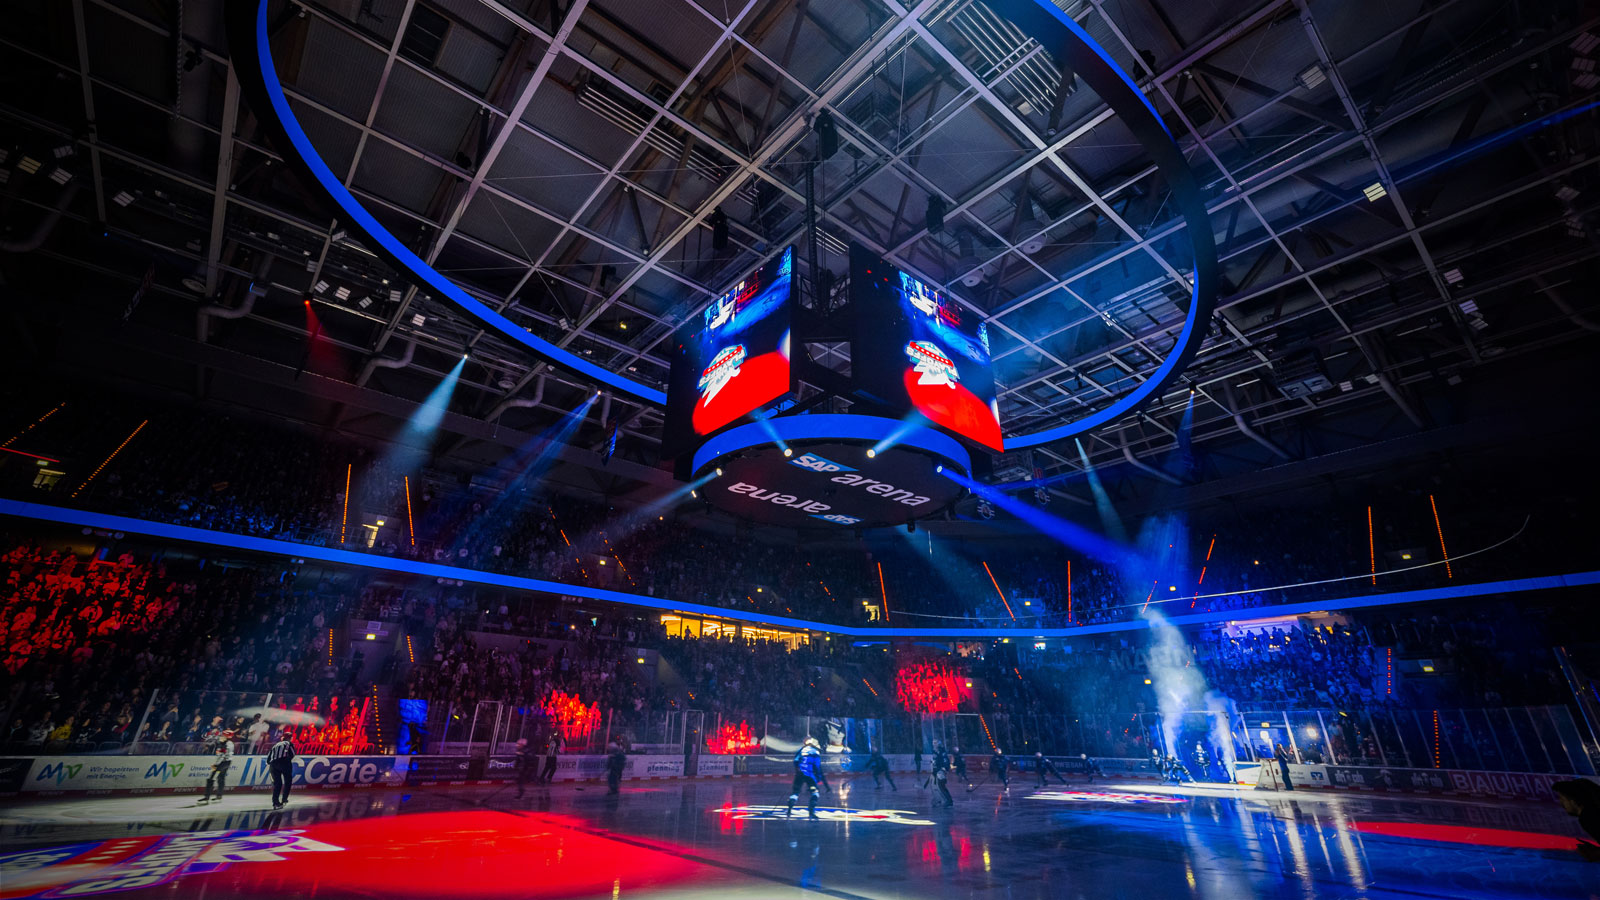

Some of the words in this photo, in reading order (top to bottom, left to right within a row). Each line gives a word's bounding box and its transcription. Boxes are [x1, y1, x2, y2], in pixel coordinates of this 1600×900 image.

[793, 454, 840, 473] SAP
[830, 473, 931, 507] arena
[727, 482, 832, 514] arena
[823, 514, 860, 525] SAP
[1452, 773, 1555, 795] BAUHA
